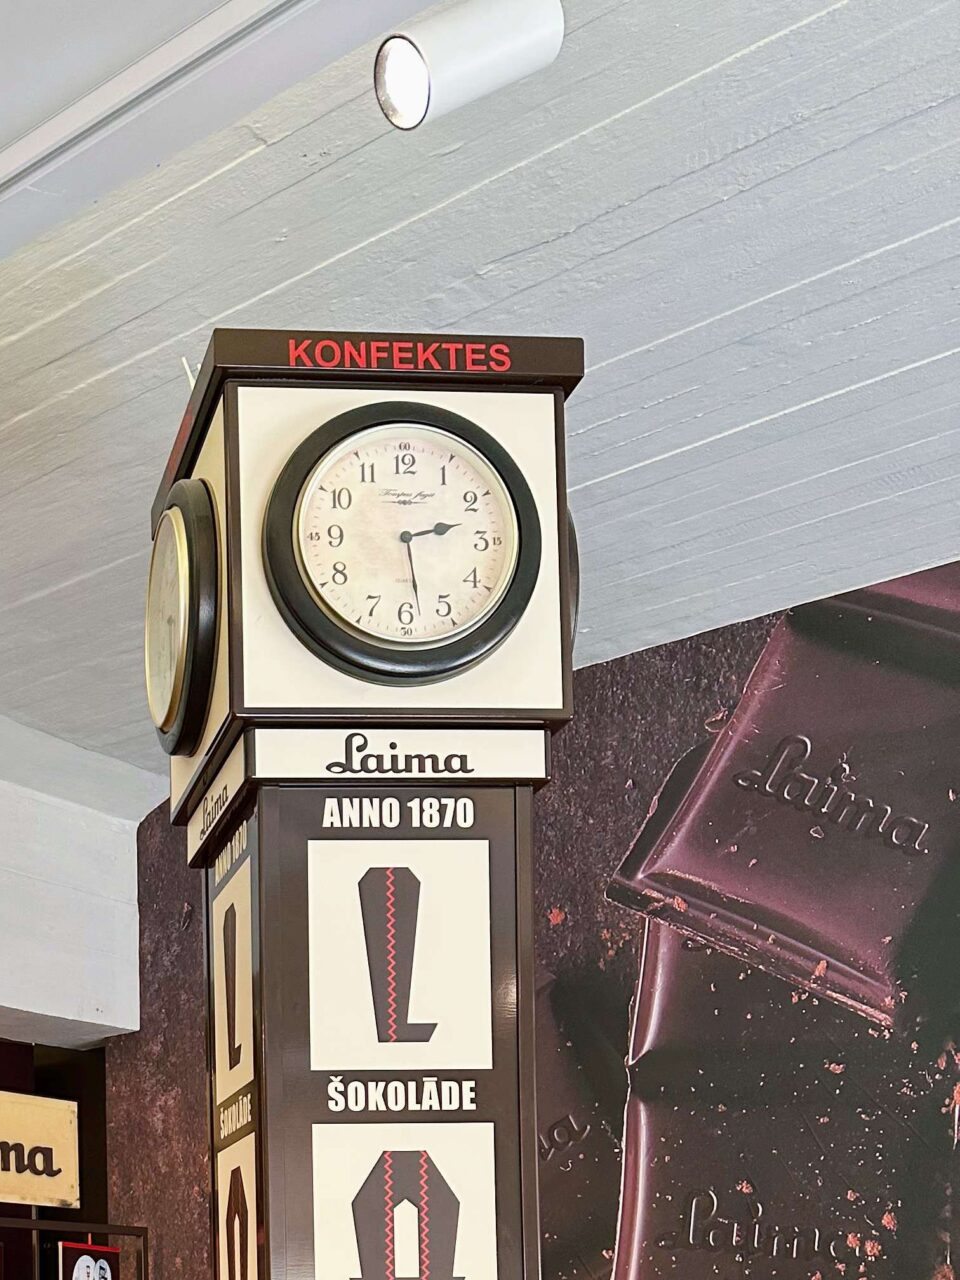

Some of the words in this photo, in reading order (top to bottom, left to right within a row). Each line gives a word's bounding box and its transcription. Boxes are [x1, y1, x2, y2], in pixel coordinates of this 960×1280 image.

[288, 339, 512, 371] KONFEKTES
[399, 442, 410, 450] 60
[360, 463, 376, 483] 11
[394, 453, 416, 475] 12
[440, 465, 447, 486] 1
[330, 487, 352, 510] 10
[463, 491, 479, 512] 2
[307, 532, 321, 541] 45
[327, 525, 344, 547] 9
[474, 530, 489, 551] 3
[493, 537, 502, 546] 15
[332, 562, 348, 585] 8
[463, 567, 481, 589] 4
[366, 595, 381, 617] 7
[398, 602, 414, 625] 6
[436, 594, 452, 617] 5
[325, 732, 475, 774] Laima
[733, 734, 928, 856] Laima
[200, 784, 229, 841] Laima
[322, 797, 400, 828] ANNO
[407, 797, 475, 828] 1870
[215, 841, 231, 887] ANNO
[231, 820, 247, 864] 1870
[357, 867, 438, 1043] L
[327, 1076, 477, 1111] ŠOKOLĀDE
